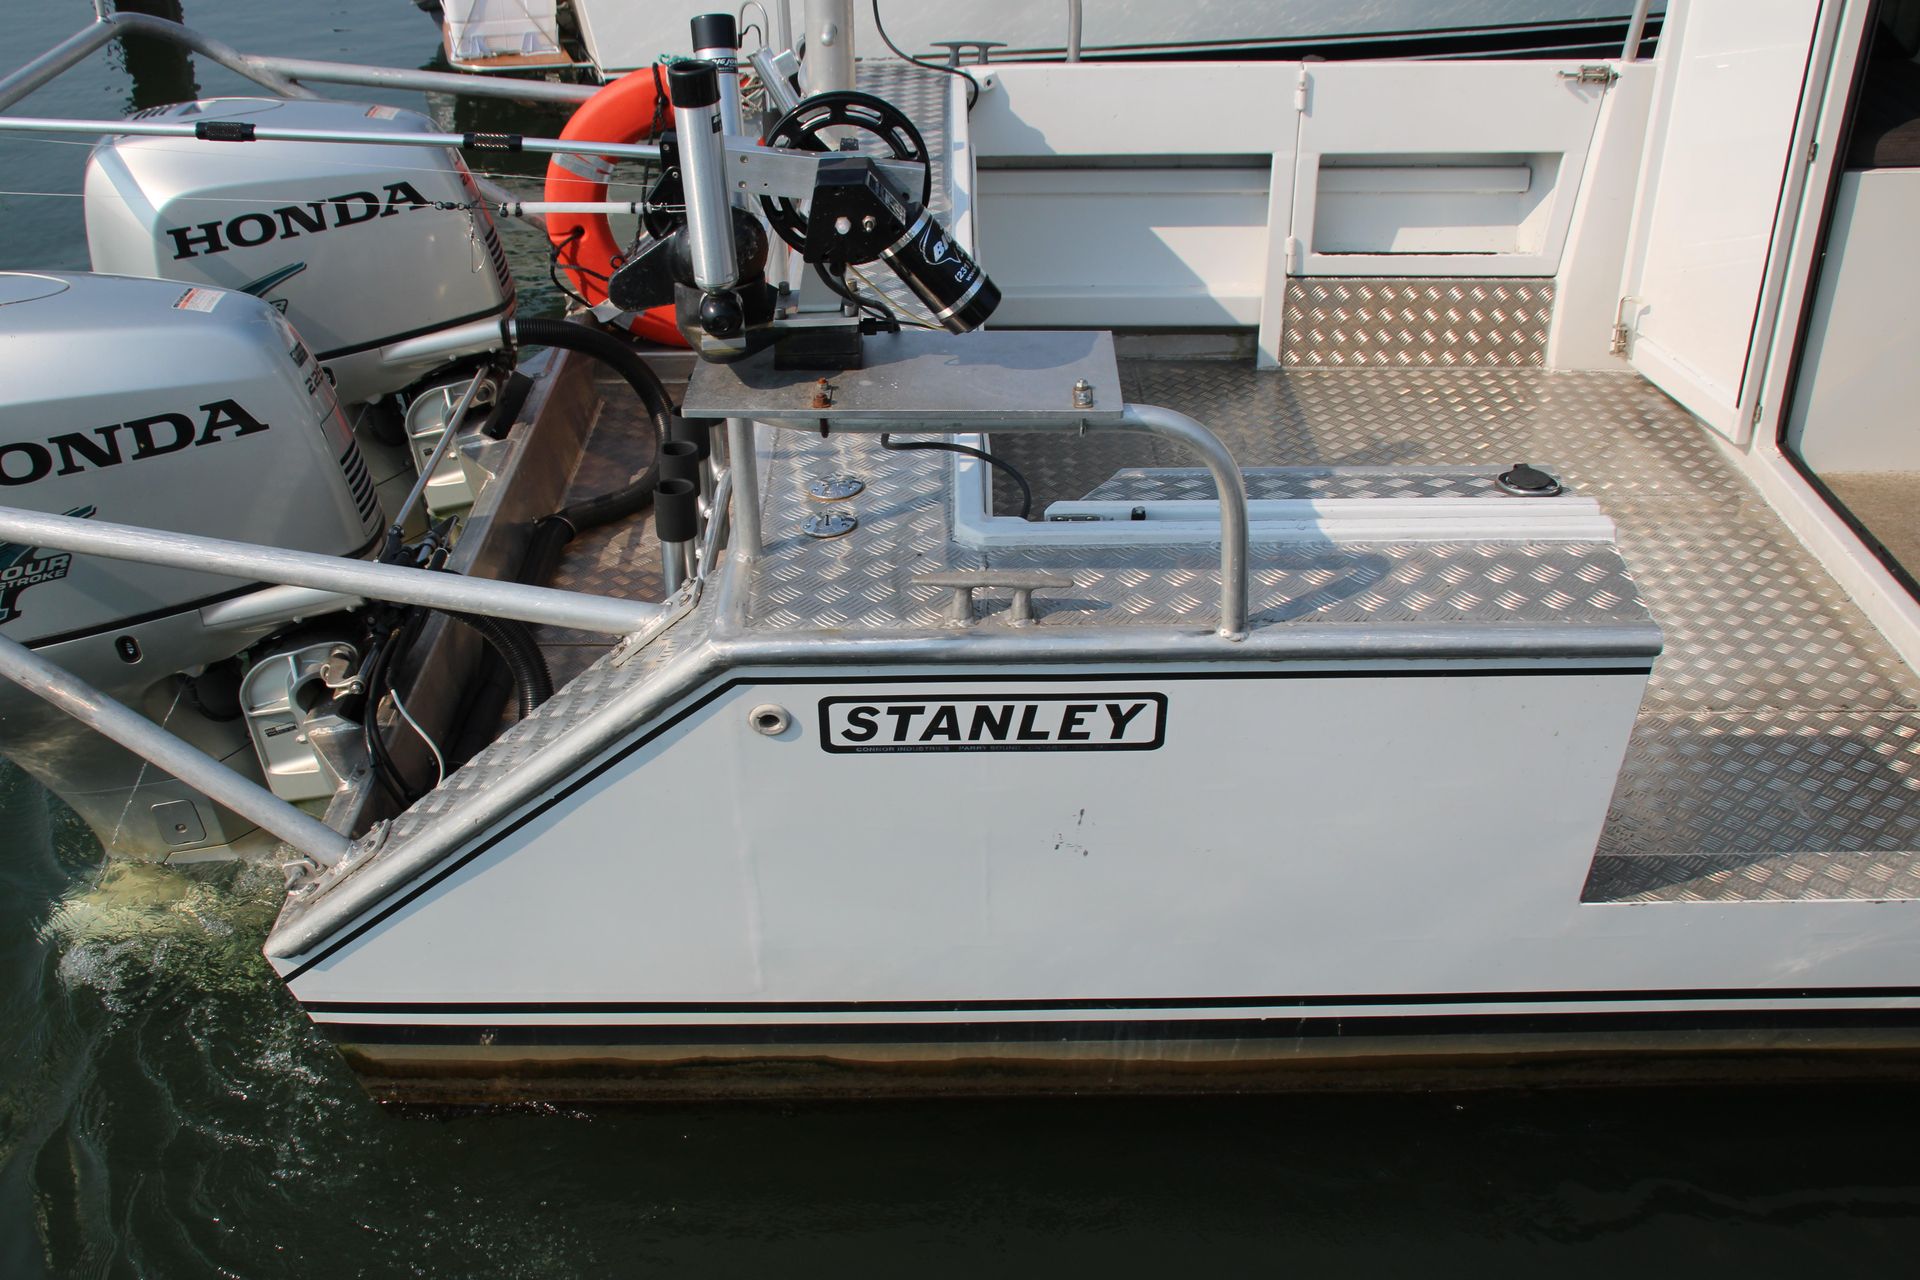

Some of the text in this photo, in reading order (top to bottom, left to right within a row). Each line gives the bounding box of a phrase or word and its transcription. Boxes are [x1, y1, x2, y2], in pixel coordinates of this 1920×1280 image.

[166, 181, 432, 260] HONDA
[0, 554, 69, 581] OUR
[0, 568, 66, 590] STROKE
[841, 703, 1147, 742] STANLEY
